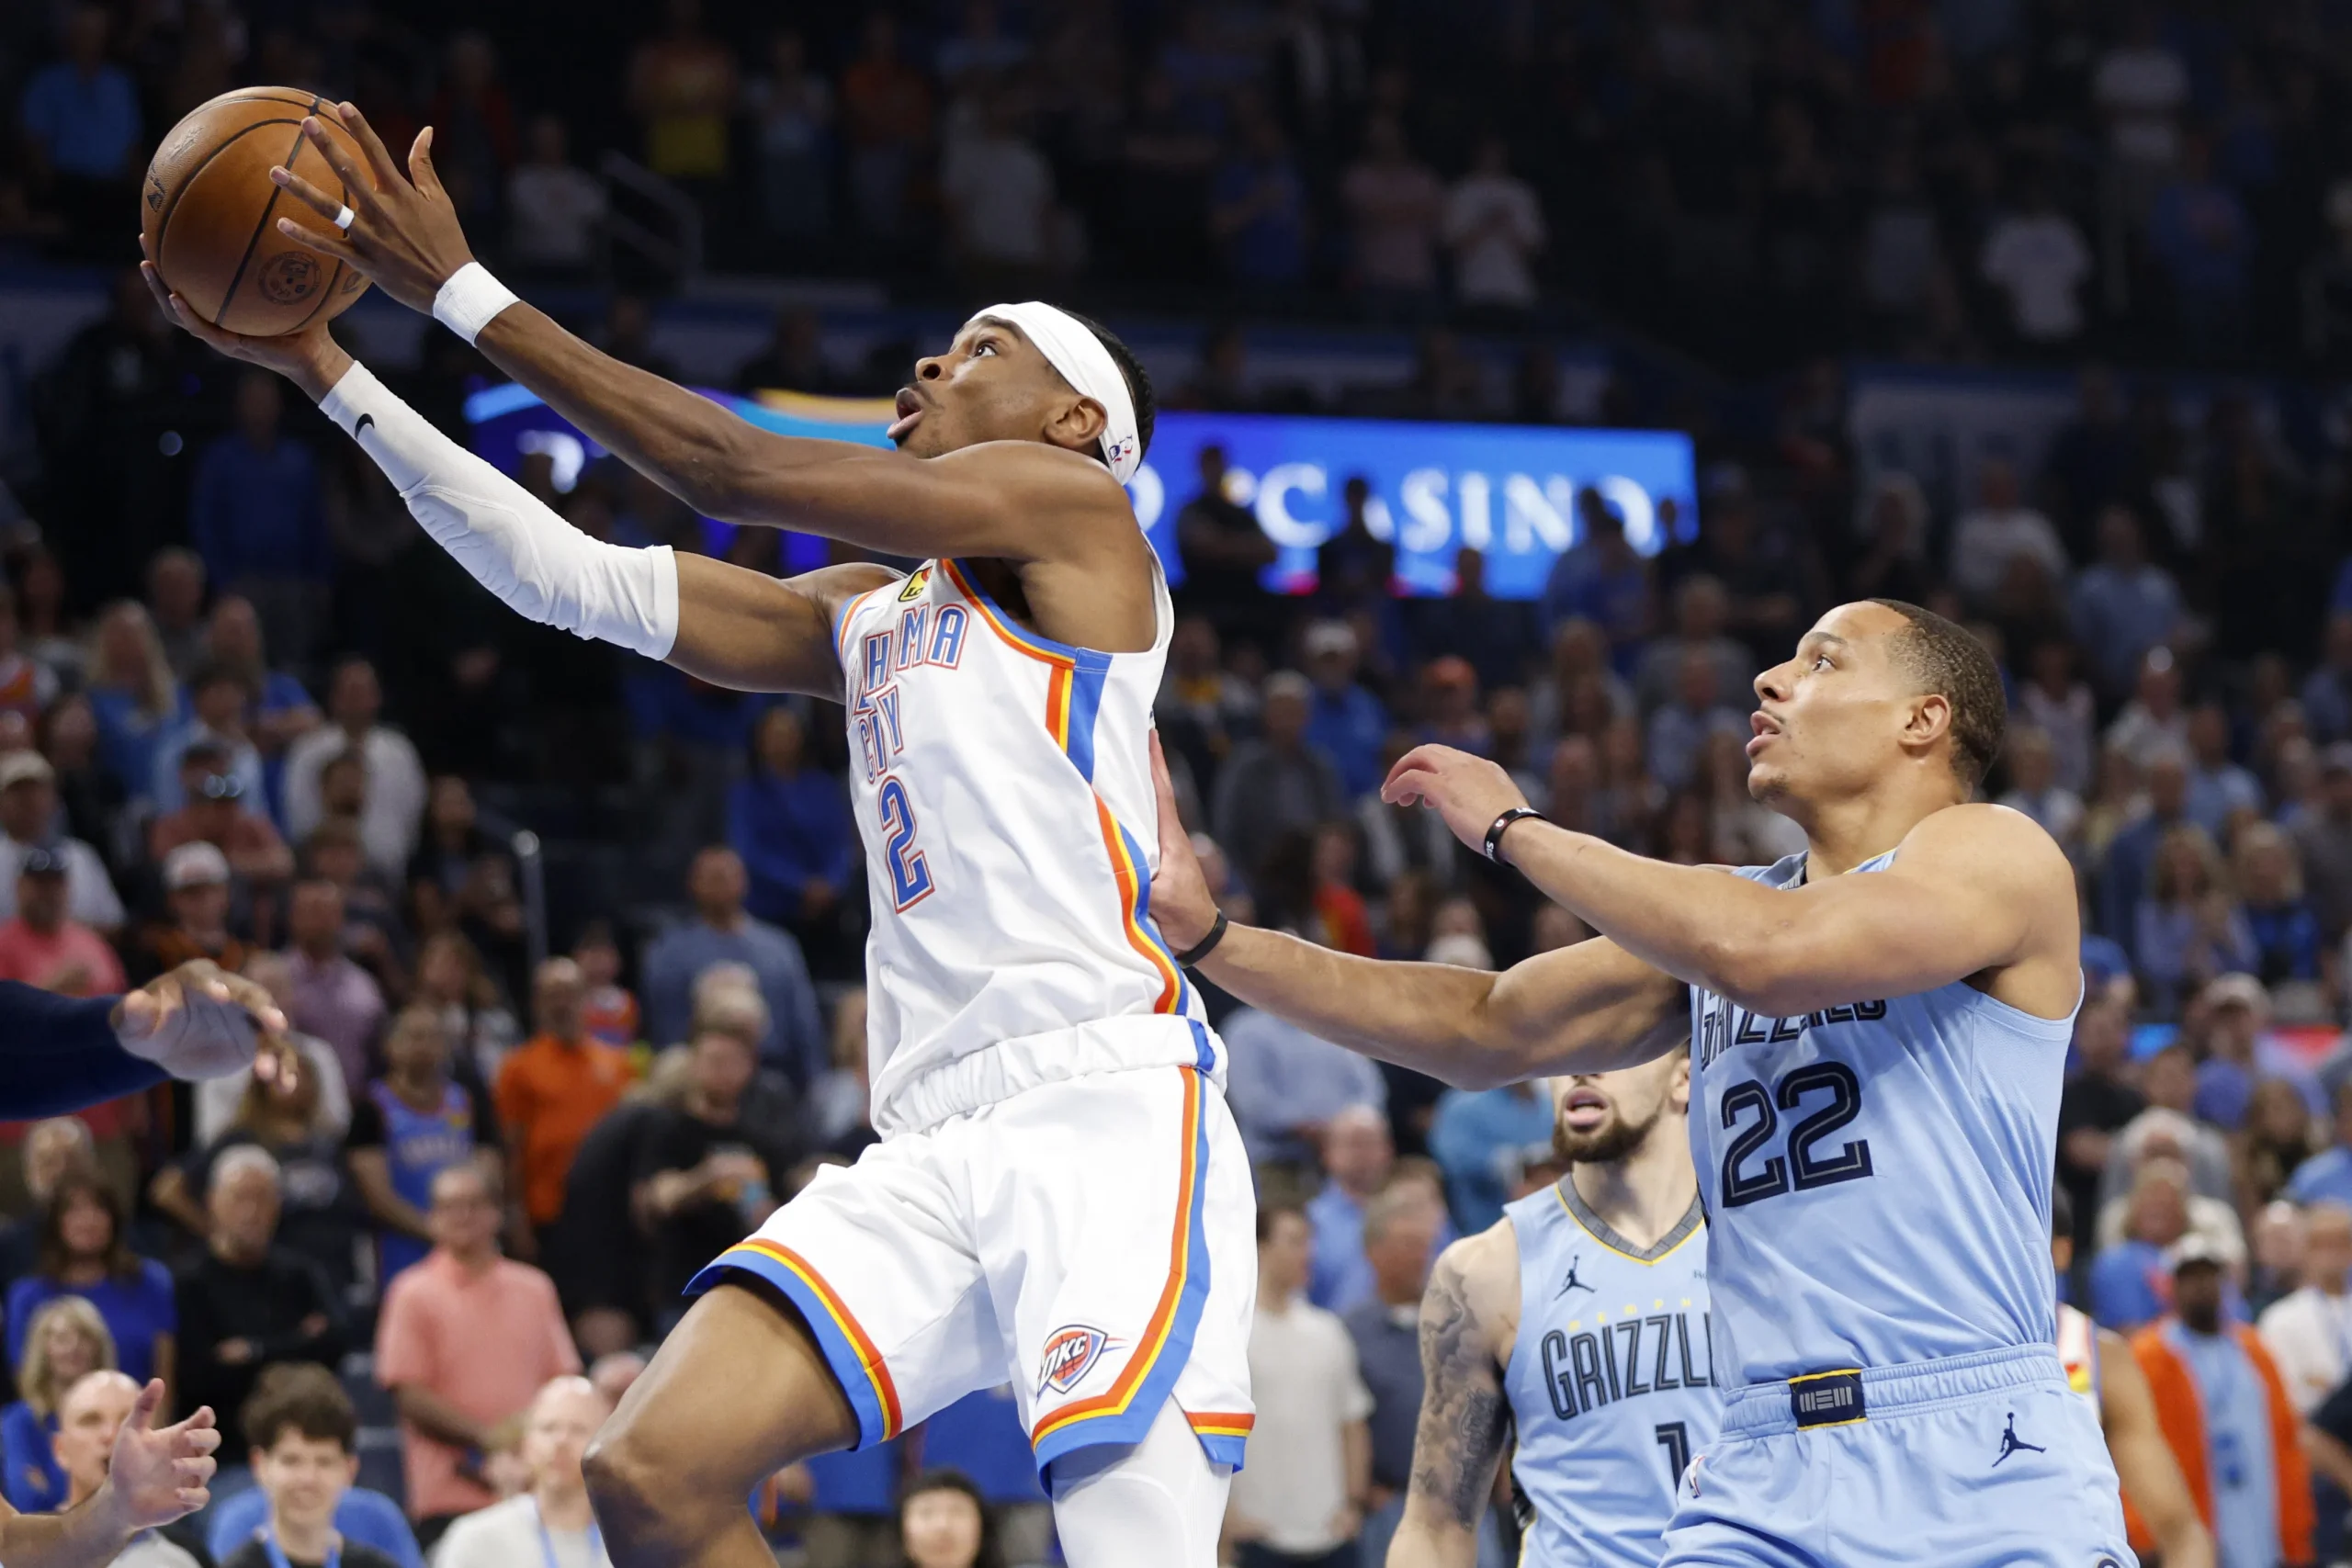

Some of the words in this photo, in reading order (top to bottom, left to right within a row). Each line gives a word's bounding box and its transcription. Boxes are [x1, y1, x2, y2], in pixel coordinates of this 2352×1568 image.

[877, 775, 935, 914] 2
[1721, 1061, 1874, 1209] 22
[1038, 1335, 1088, 1388] OKC
